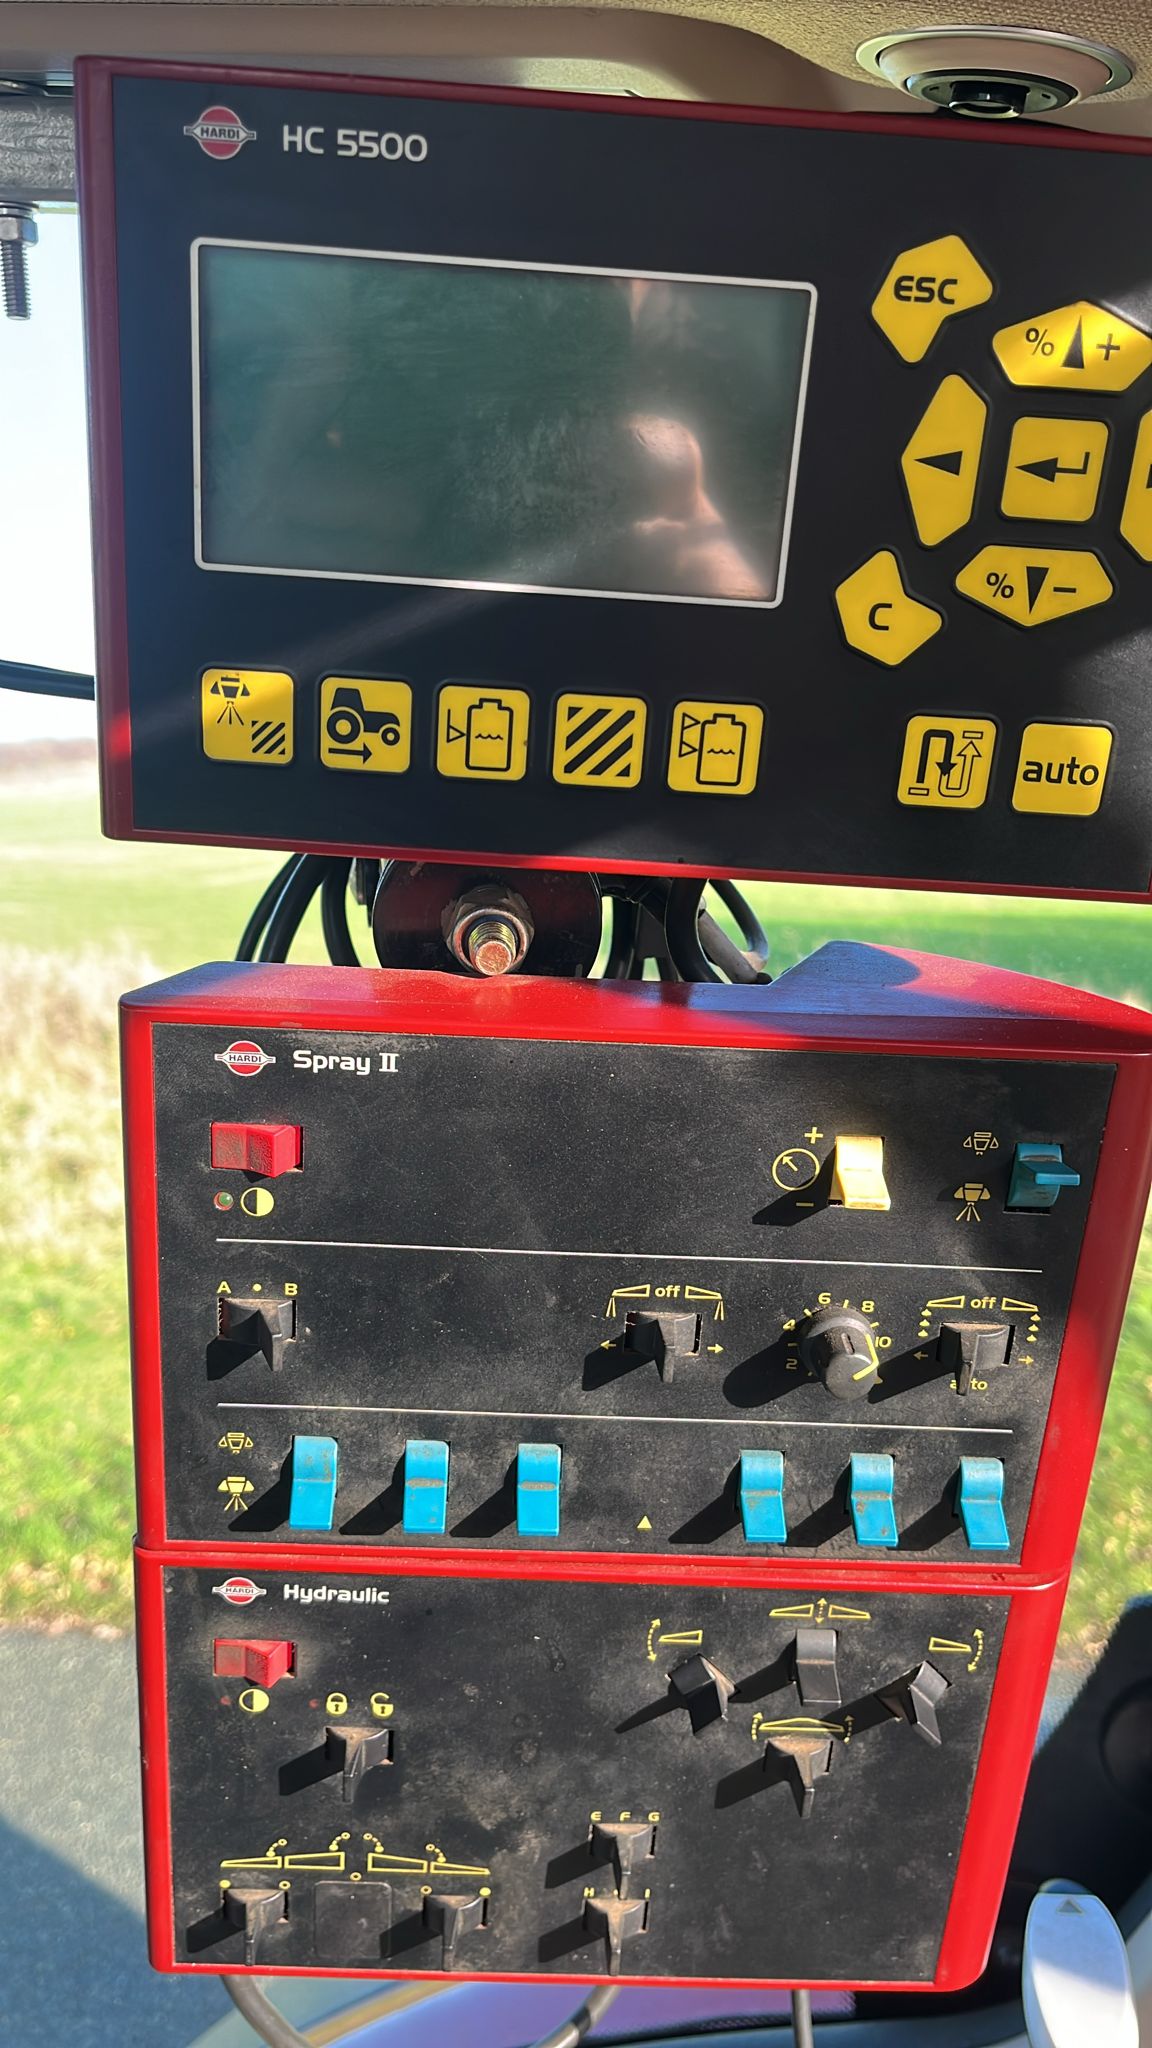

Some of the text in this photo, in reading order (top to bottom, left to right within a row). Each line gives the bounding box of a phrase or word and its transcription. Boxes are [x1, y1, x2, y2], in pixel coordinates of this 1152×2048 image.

[200, 125, 241, 141] HARDI
[282, 124, 429, 163] HC 5500
[893, 275, 958, 306] ESC
[868, 602, 891, 631] C
[1022, 756, 1099, 787] auto
[228, 1054, 262, 1063] HARDI
[292, 1049, 370, 1076] Spray
[217, 1281, 298, 1296] A B
[654, 1284, 681, 1299] off
[818, 1292, 831, 1305] 6
[970, 1296, 996, 1310] off
[861, 1301, 875, 1313] 8
[782, 1319, 796, 1332] 4
[875, 1336, 892, 1348] 10
[785, 1358, 798, 1370] 2
[950, 1376, 989, 1391] ato
[225, 1586, 255, 1595] HARDI
[283, 1583, 390, 1605] Hydraulic
[590, 1811, 660, 1822] E F G
[583, 1886, 595, 1898] H
